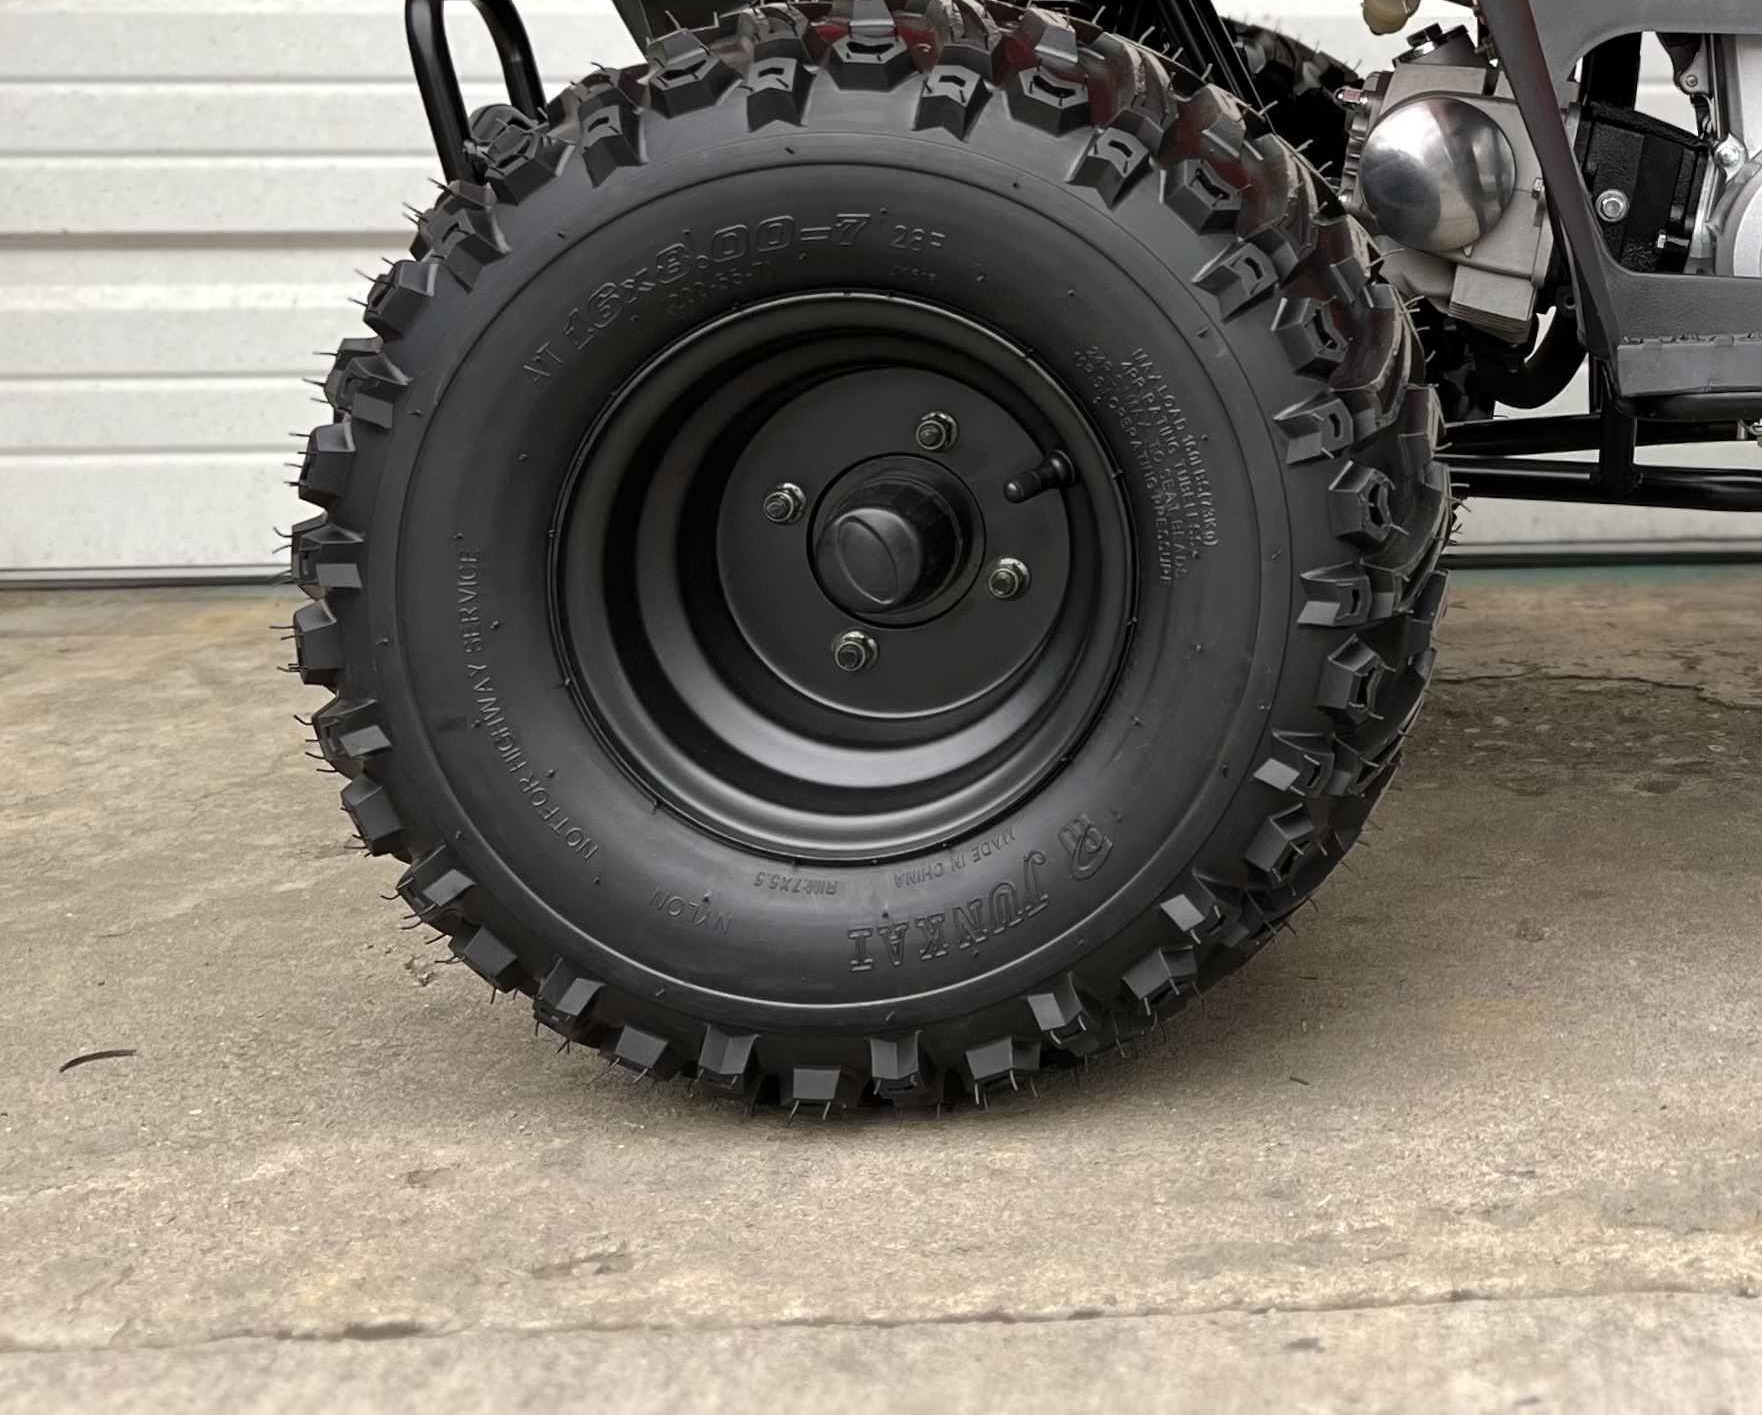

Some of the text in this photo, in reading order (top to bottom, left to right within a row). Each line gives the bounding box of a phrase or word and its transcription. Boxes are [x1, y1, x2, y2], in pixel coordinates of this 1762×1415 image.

[522, 340, 566, 389] AT
[1142, 391, 1180, 455] RATING
[1173, 457, 1204, 547] TUBELESS
[1148, 439, 1166, 464] TO
[1158, 467, 1180, 512] SEAT
[1150, 492, 1173, 586] PRESSURE
[456, 547, 599, 861] NOT FOR HIGHWAY SERVICE
[891, 826, 1018, 888] MADE IN CHINA
[648, 886, 733, 935] NYLON
[847, 849, 1050, 972] JUNKAI
